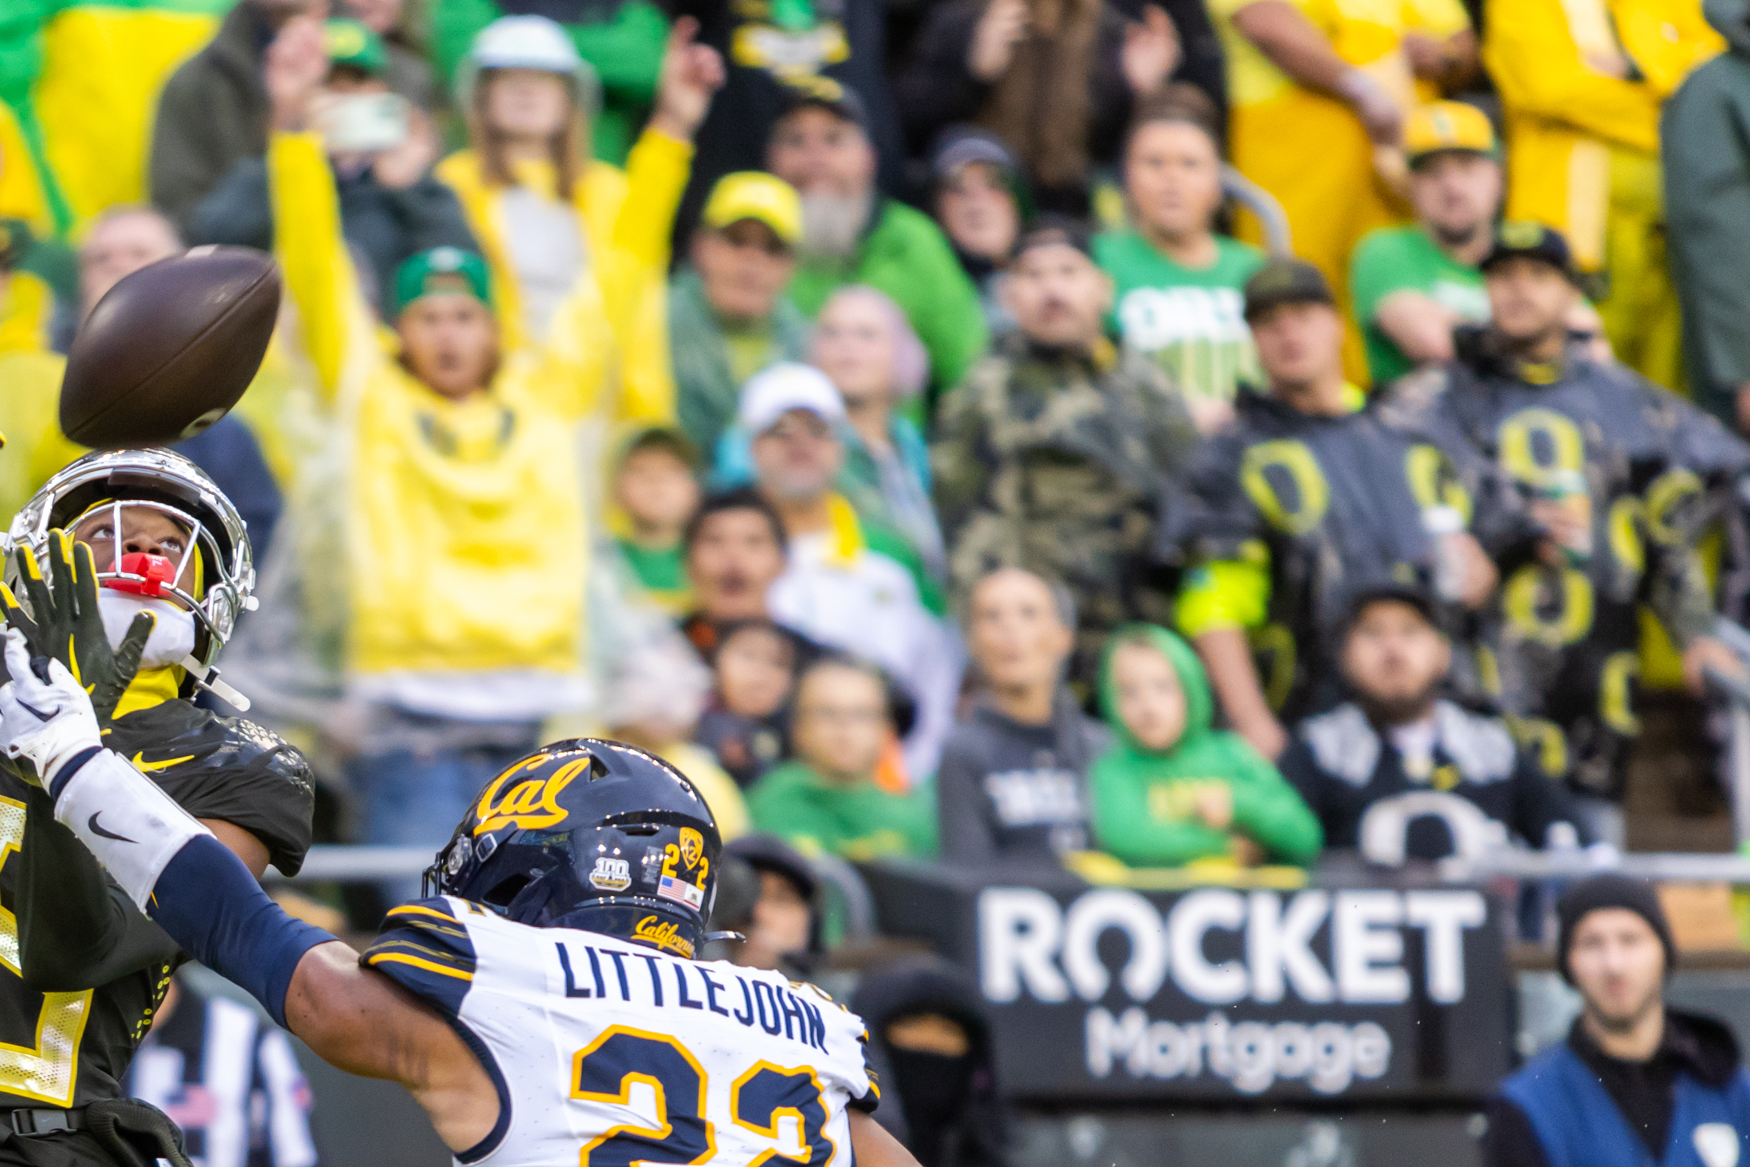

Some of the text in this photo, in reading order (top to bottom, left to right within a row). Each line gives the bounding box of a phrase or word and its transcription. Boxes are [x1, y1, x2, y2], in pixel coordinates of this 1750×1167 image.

[474, 753, 590, 836] Cal
[597, 859, 628, 876] 100
[633, 915, 696, 957] Californi
[978, 886, 1487, 1003] ROCKET
[555, 942, 829, 1056] LITTLEJOHN
[1084, 1006, 1392, 1095] Mortgage
